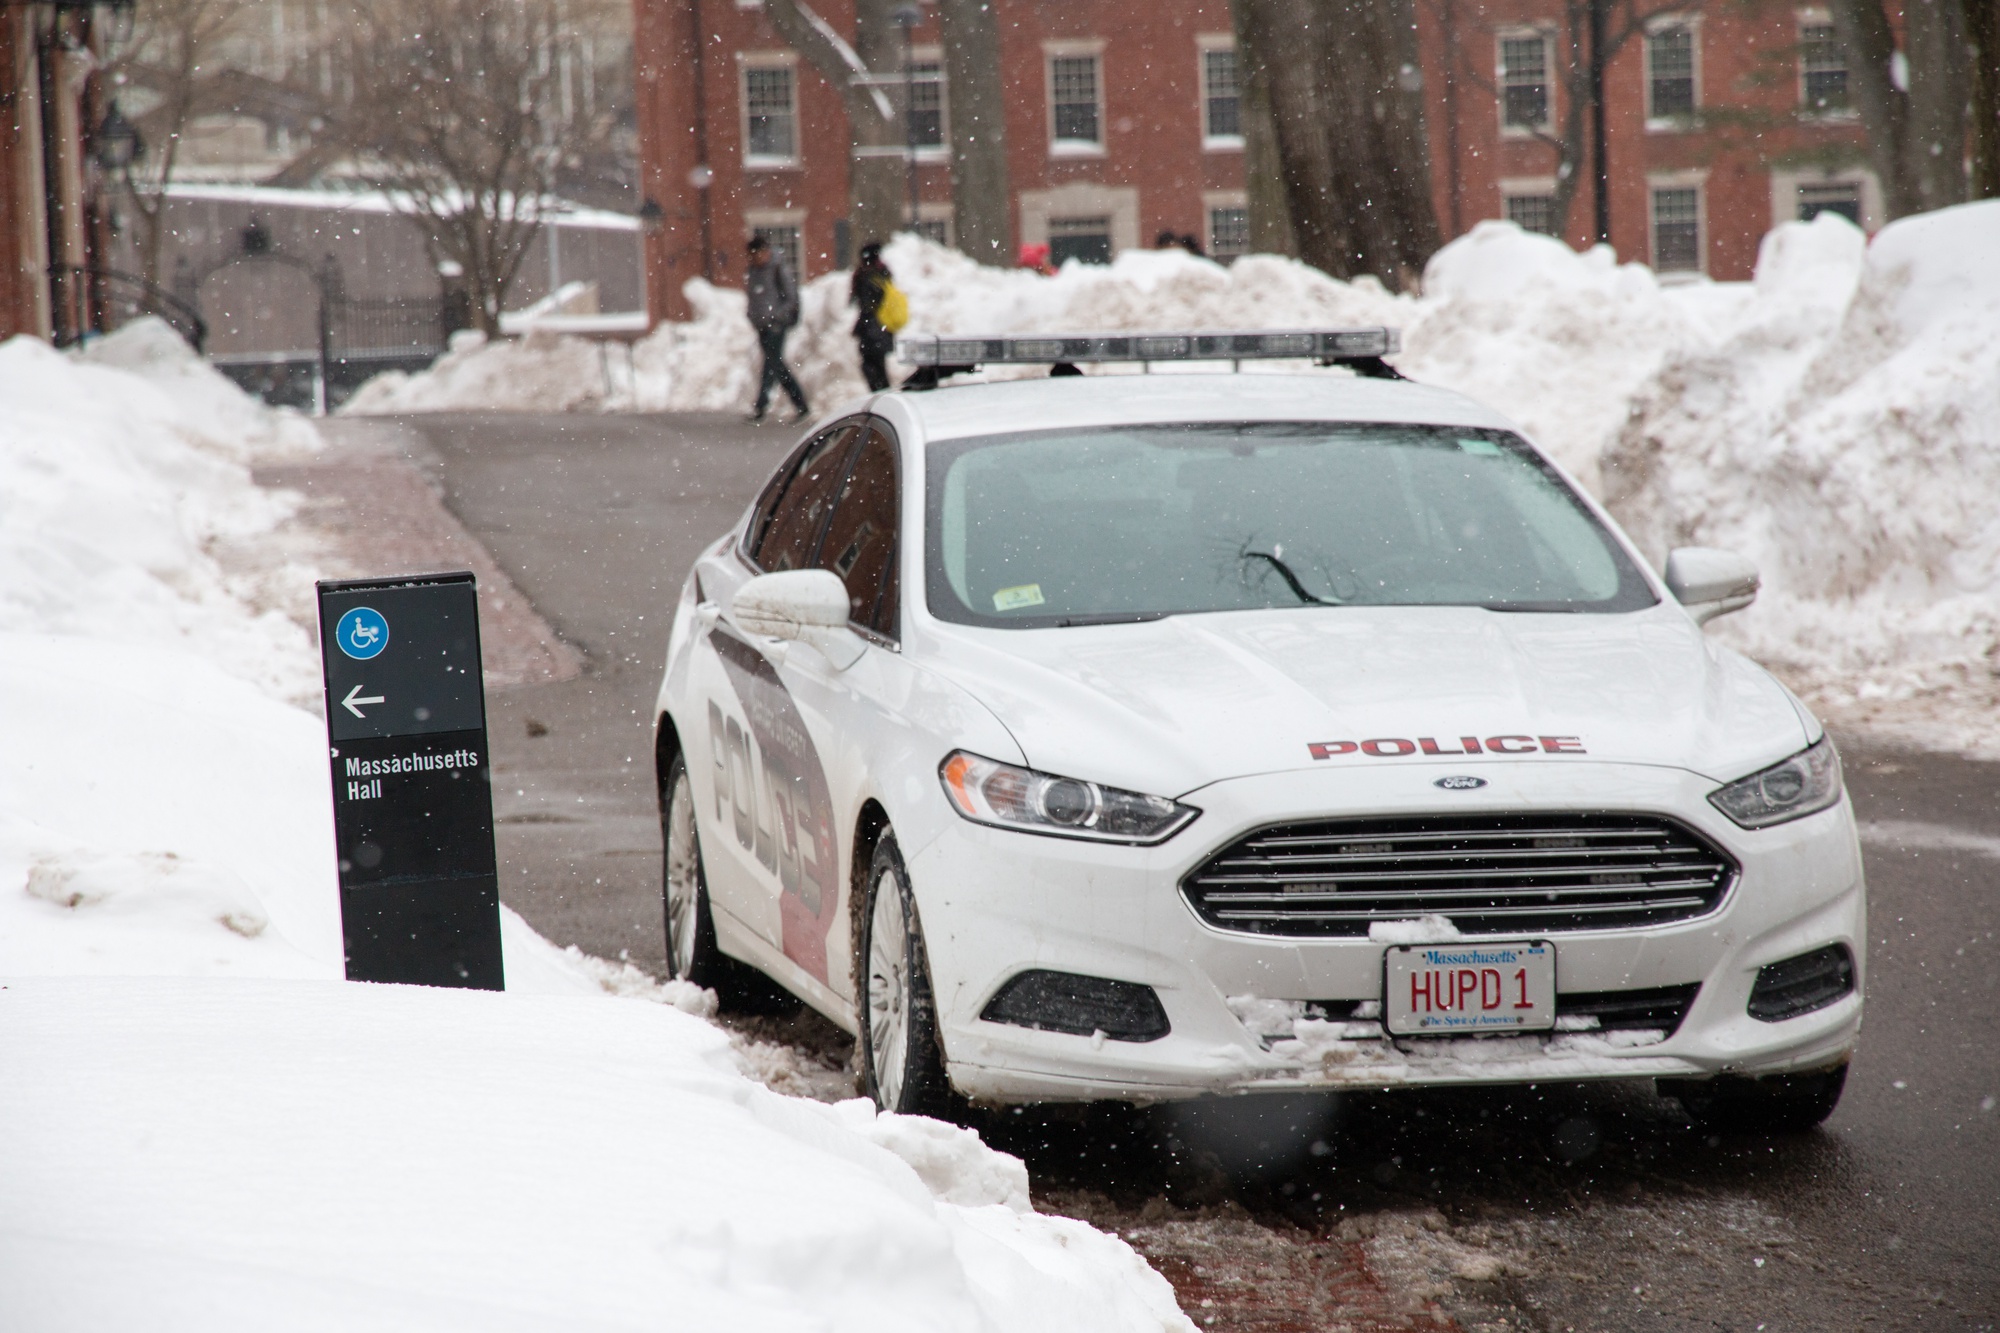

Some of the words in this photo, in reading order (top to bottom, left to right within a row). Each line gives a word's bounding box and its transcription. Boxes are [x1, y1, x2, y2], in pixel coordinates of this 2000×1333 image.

[1306, 735, 1587, 760] POLICE
[346, 750, 478, 776] Massachusetts
[348, 779, 382, 800] Hall
[1426, 950, 1517, 965] Massachusetts
[1411, 969, 1501, 1012] HUPD
[1514, 968, 1534, 1009] 1
[1427, 1016, 1441, 1026] The
[1444, 1015, 1467, 1027] Spirit
[1469, 1015, 1478, 1026] of
[1480, 1015, 1516, 1025] America
